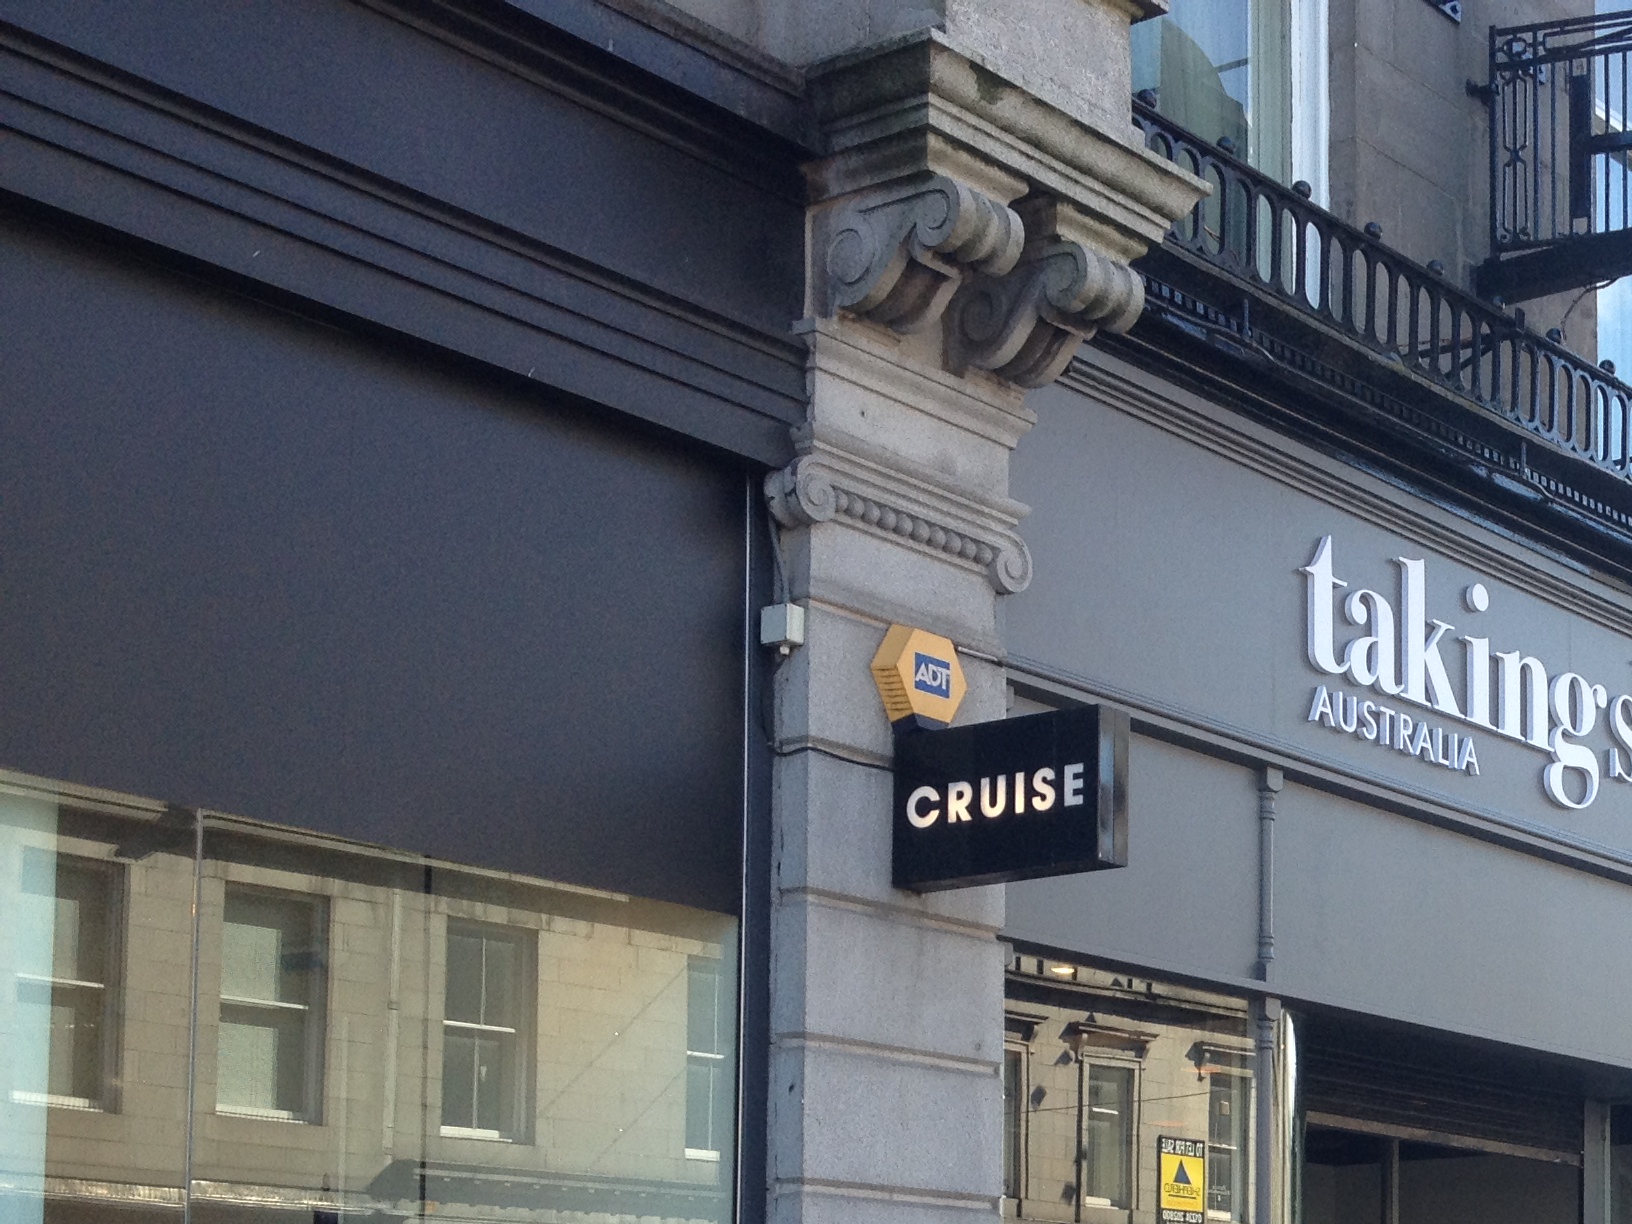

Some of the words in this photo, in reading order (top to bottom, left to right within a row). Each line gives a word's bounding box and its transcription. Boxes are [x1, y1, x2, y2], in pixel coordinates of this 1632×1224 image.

[915, 663, 950, 690] ADT
[1307, 684, 1481, 776] AUSTRALIA
[905, 762, 1085, 829] CRUISE
